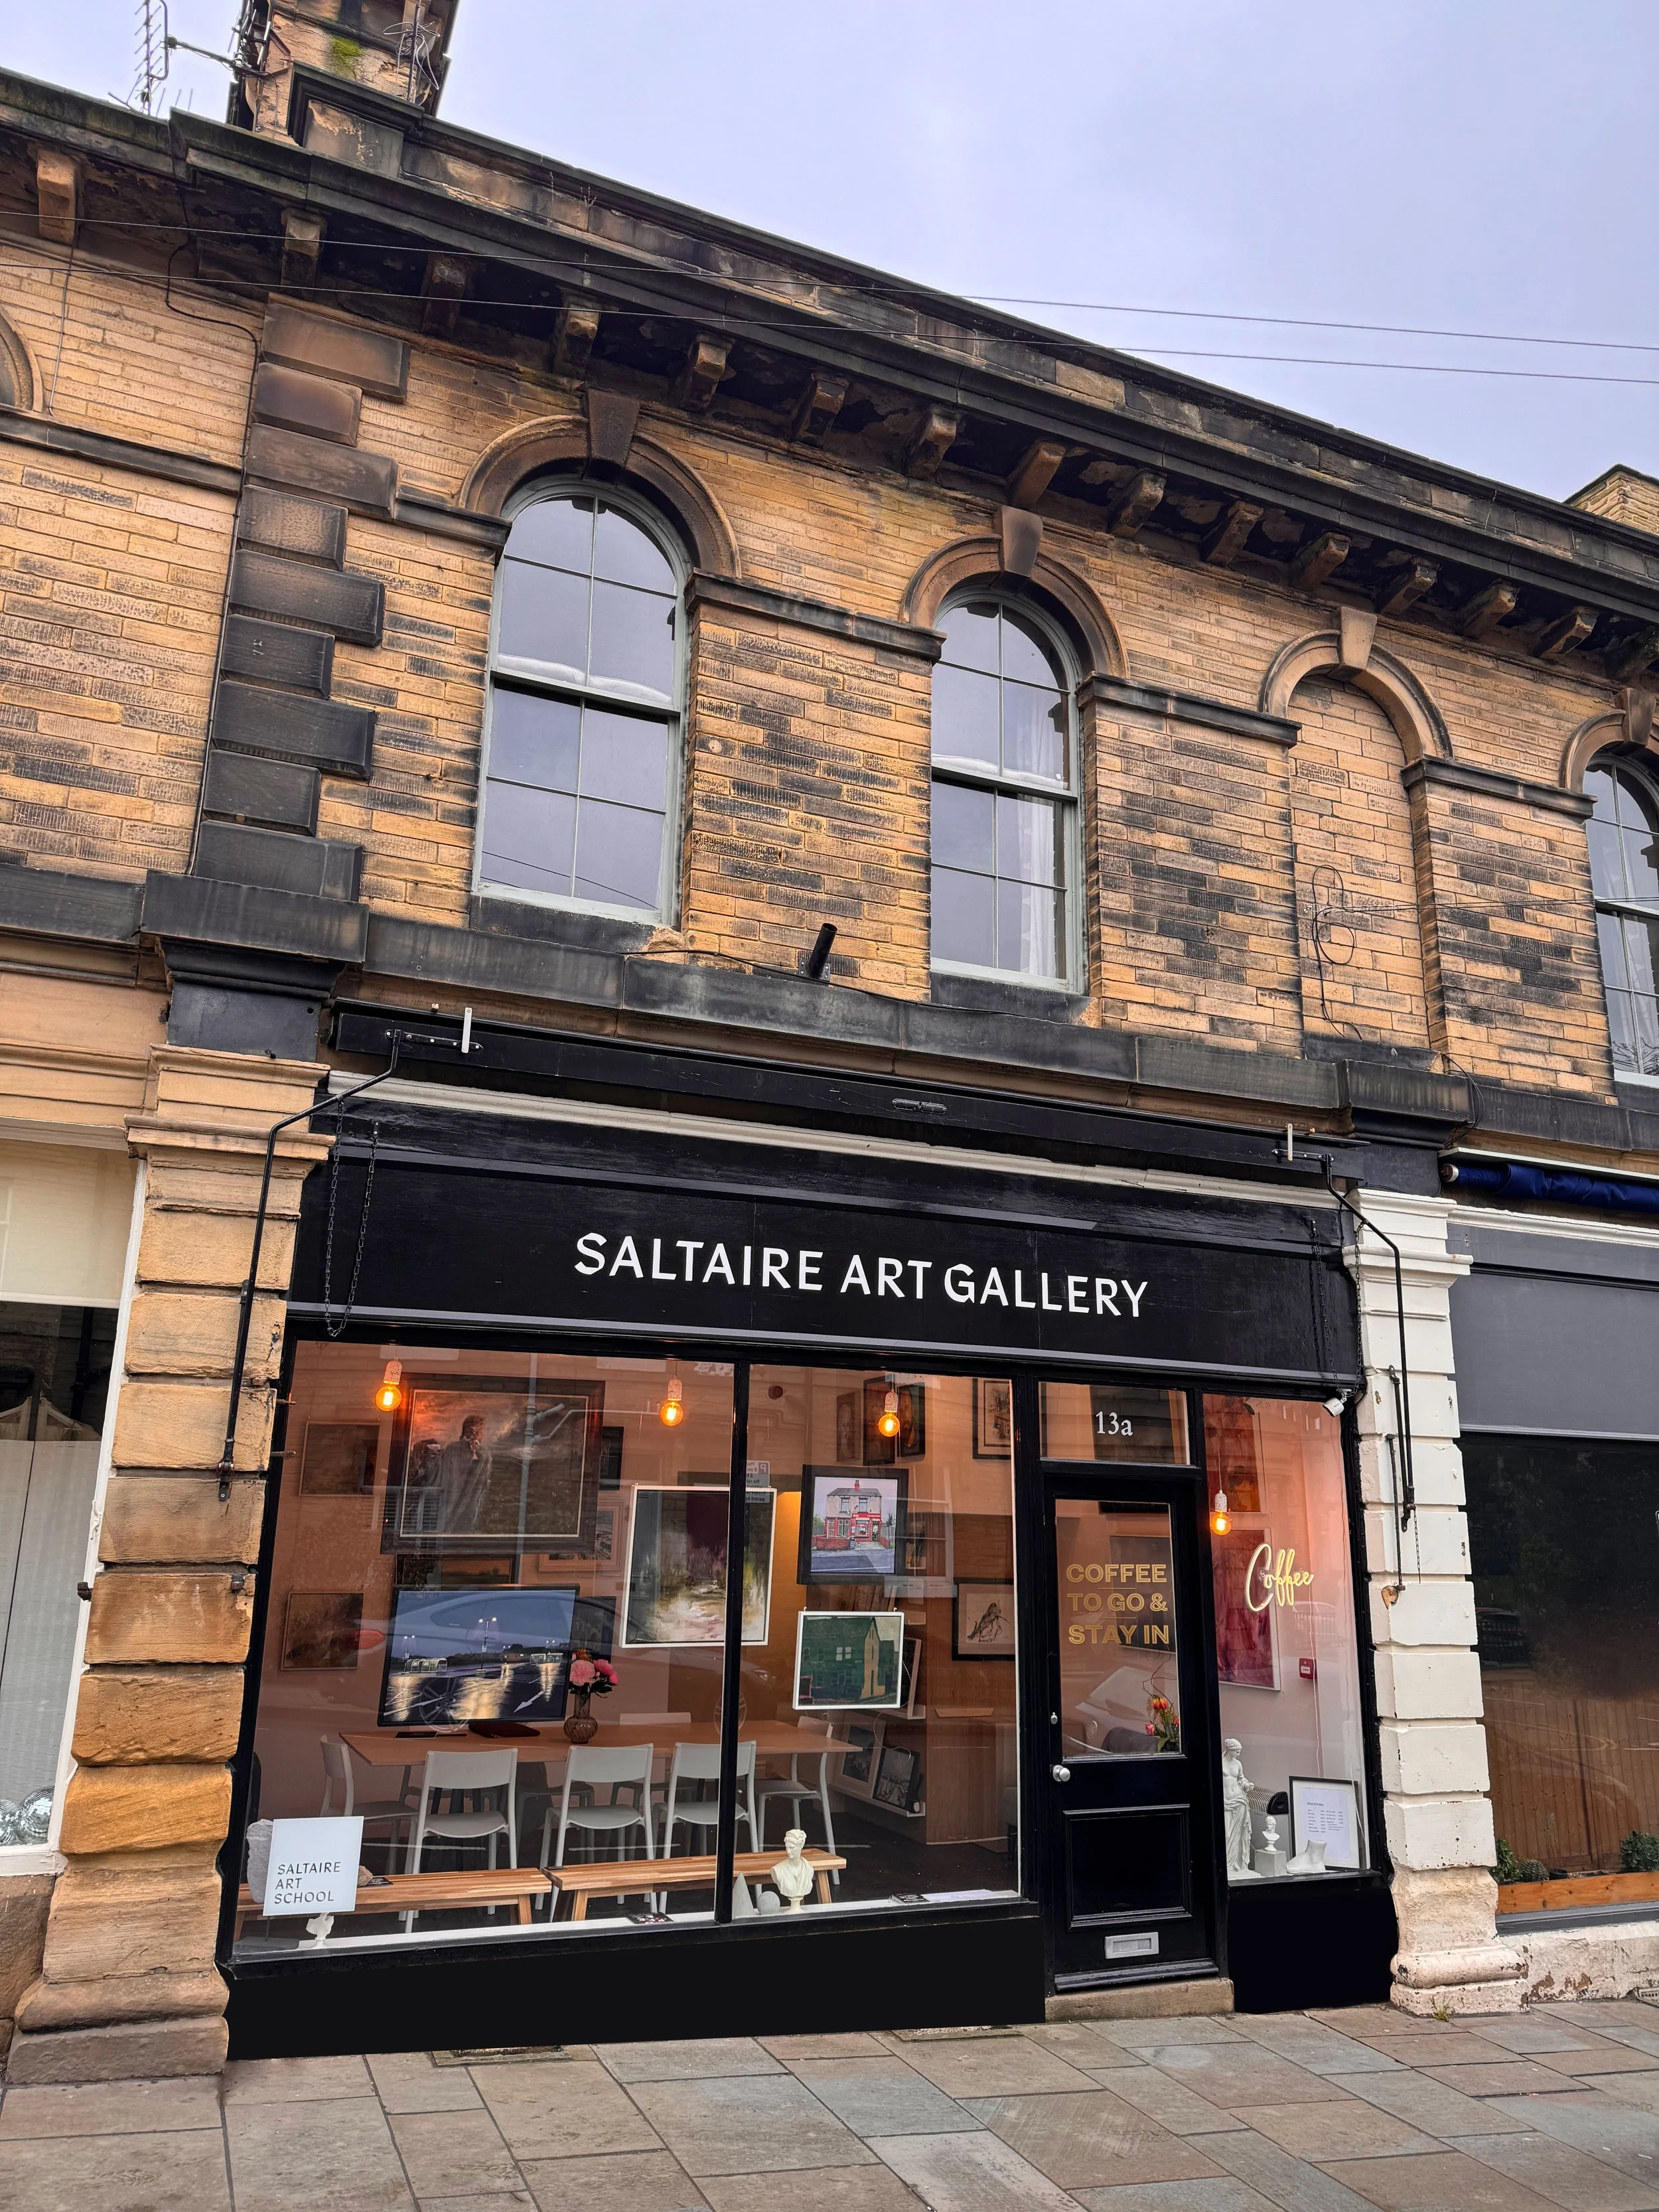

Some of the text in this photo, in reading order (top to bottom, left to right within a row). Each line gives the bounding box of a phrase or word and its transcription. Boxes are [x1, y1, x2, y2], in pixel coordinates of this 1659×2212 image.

[574, 1232, 1148, 1317] SALTAIRE ART GALLERY
[1096, 1411, 1133, 1436] 13a
[1066, 1564, 1167, 1583] COFFEE
[1245, 1543, 1315, 1612] Coffee
[1066, 1593, 1168, 1612] TO GO &
[1068, 1625, 1169, 1645] STAY IN
[277, 1862, 341, 1875] SALTAIRE
[275, 1878, 303, 1889] ART
[273, 1891, 334, 1904] SCHOOL
